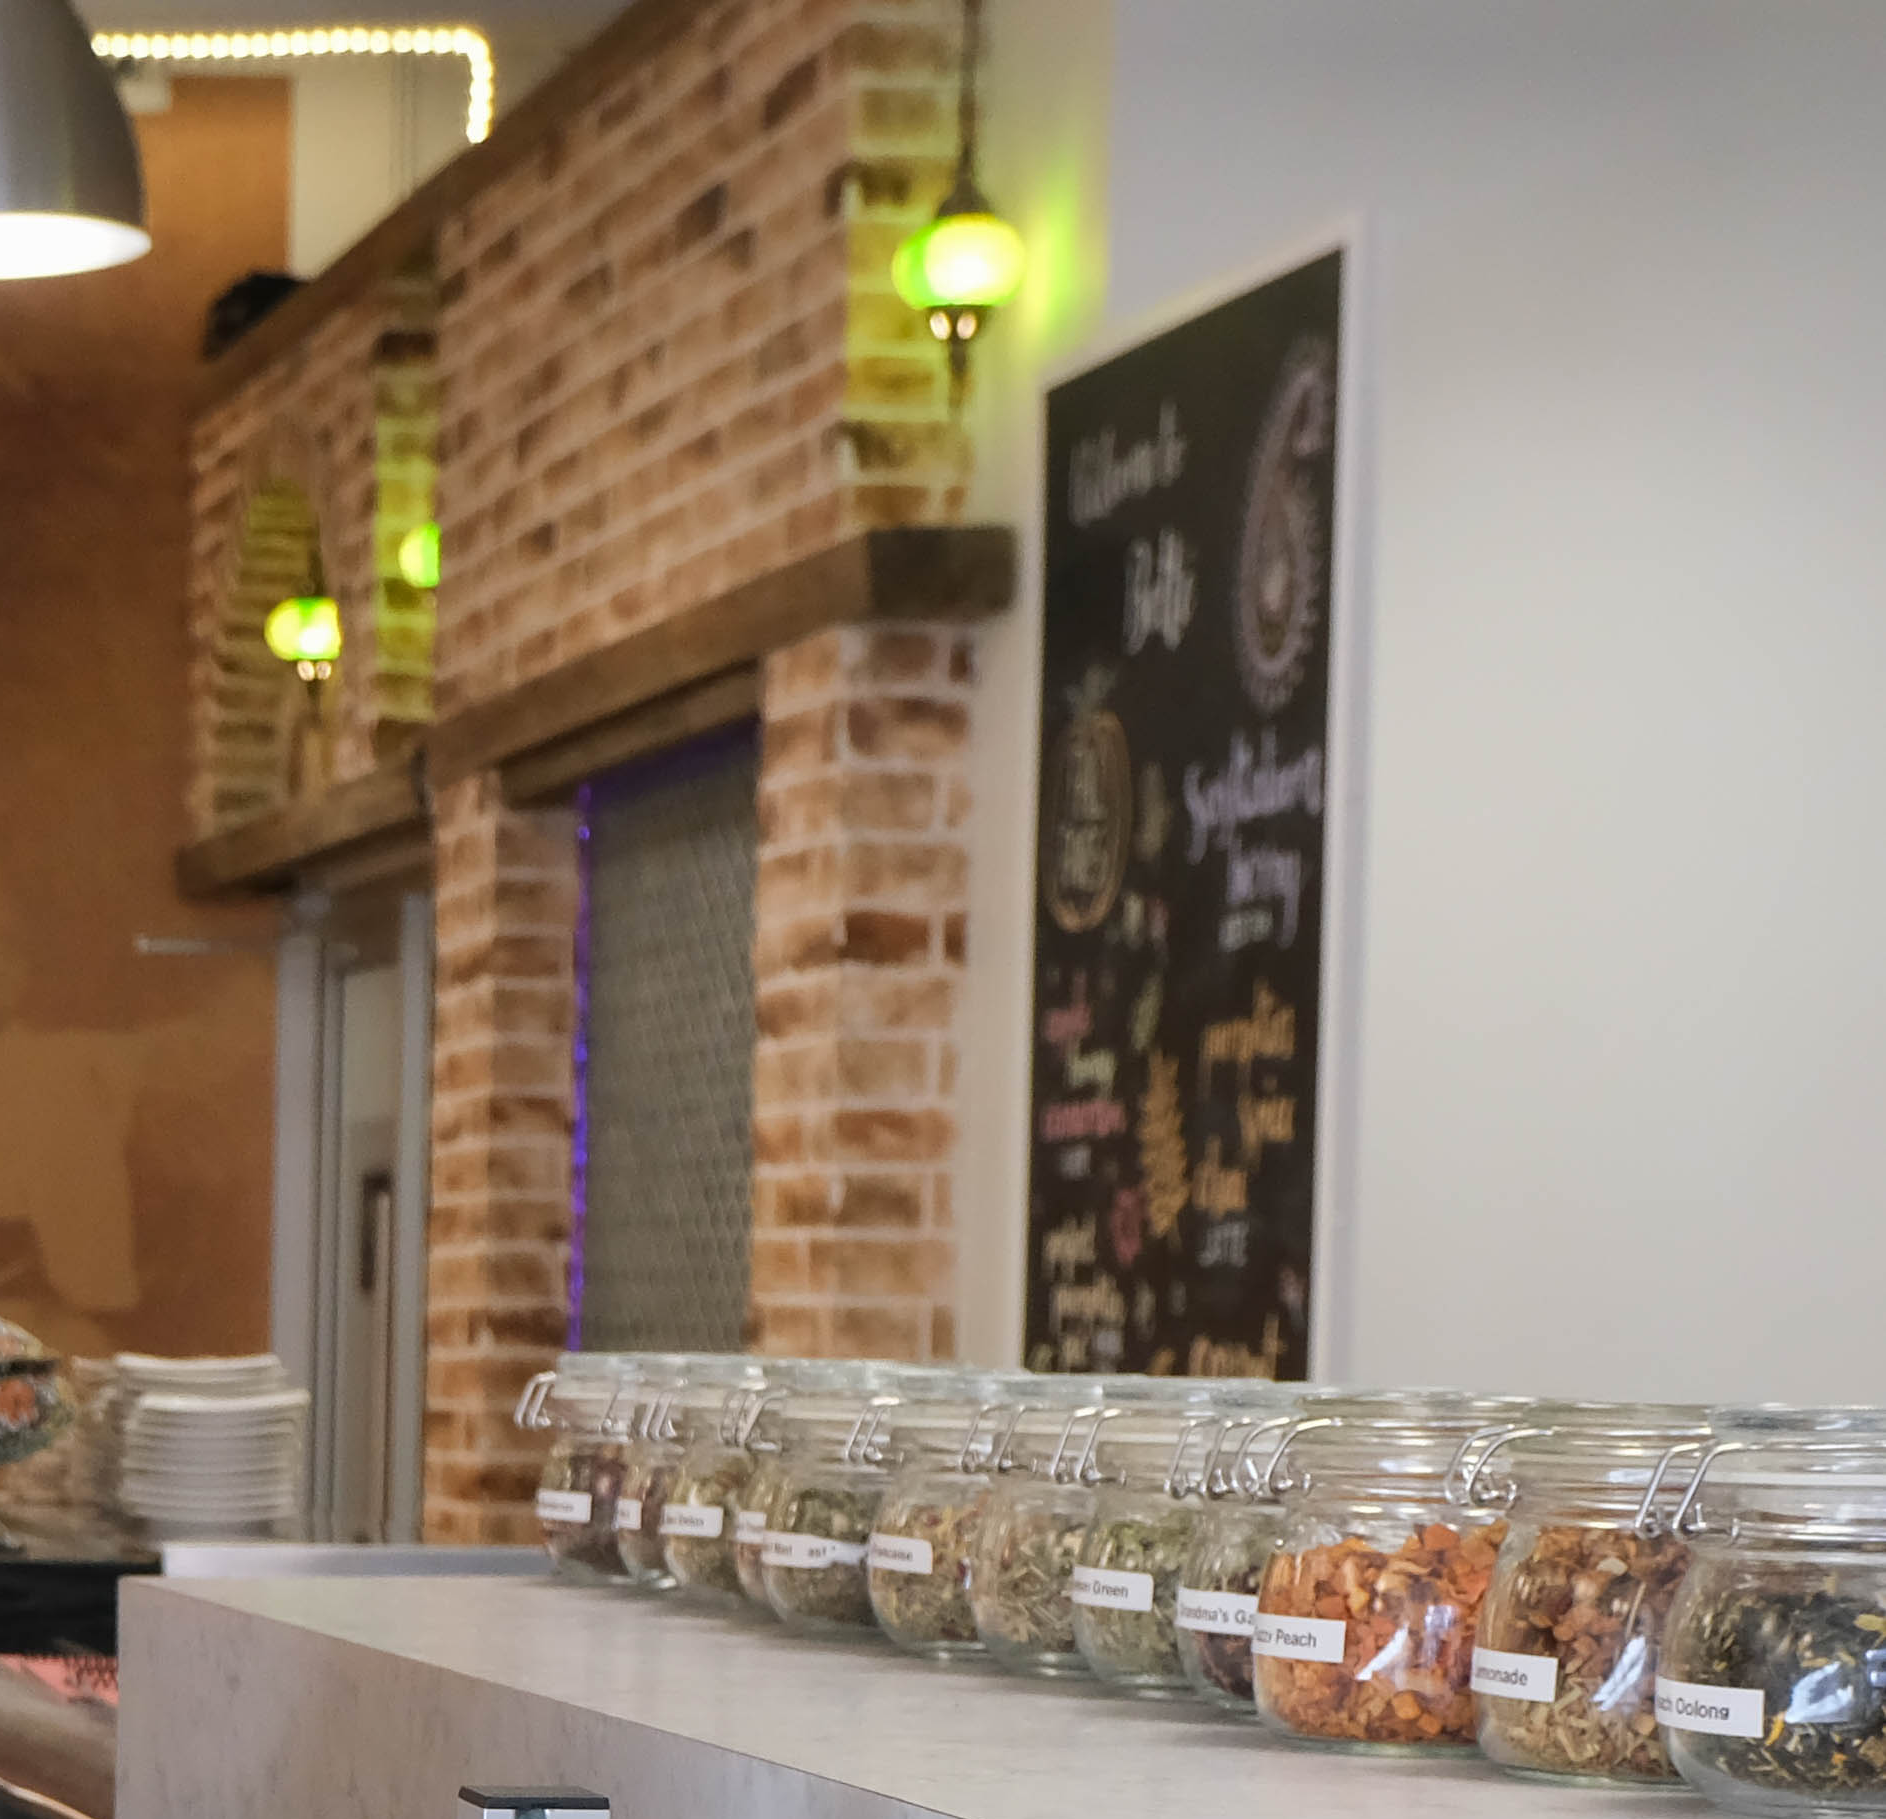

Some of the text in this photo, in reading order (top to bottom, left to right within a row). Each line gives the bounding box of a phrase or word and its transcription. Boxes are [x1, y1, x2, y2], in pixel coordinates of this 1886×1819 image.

[1092, 1580, 1129, 1599] Green
[1275, 1628, 1317, 1648] Peach
[1675, 1697, 1730, 1720] Oolong
